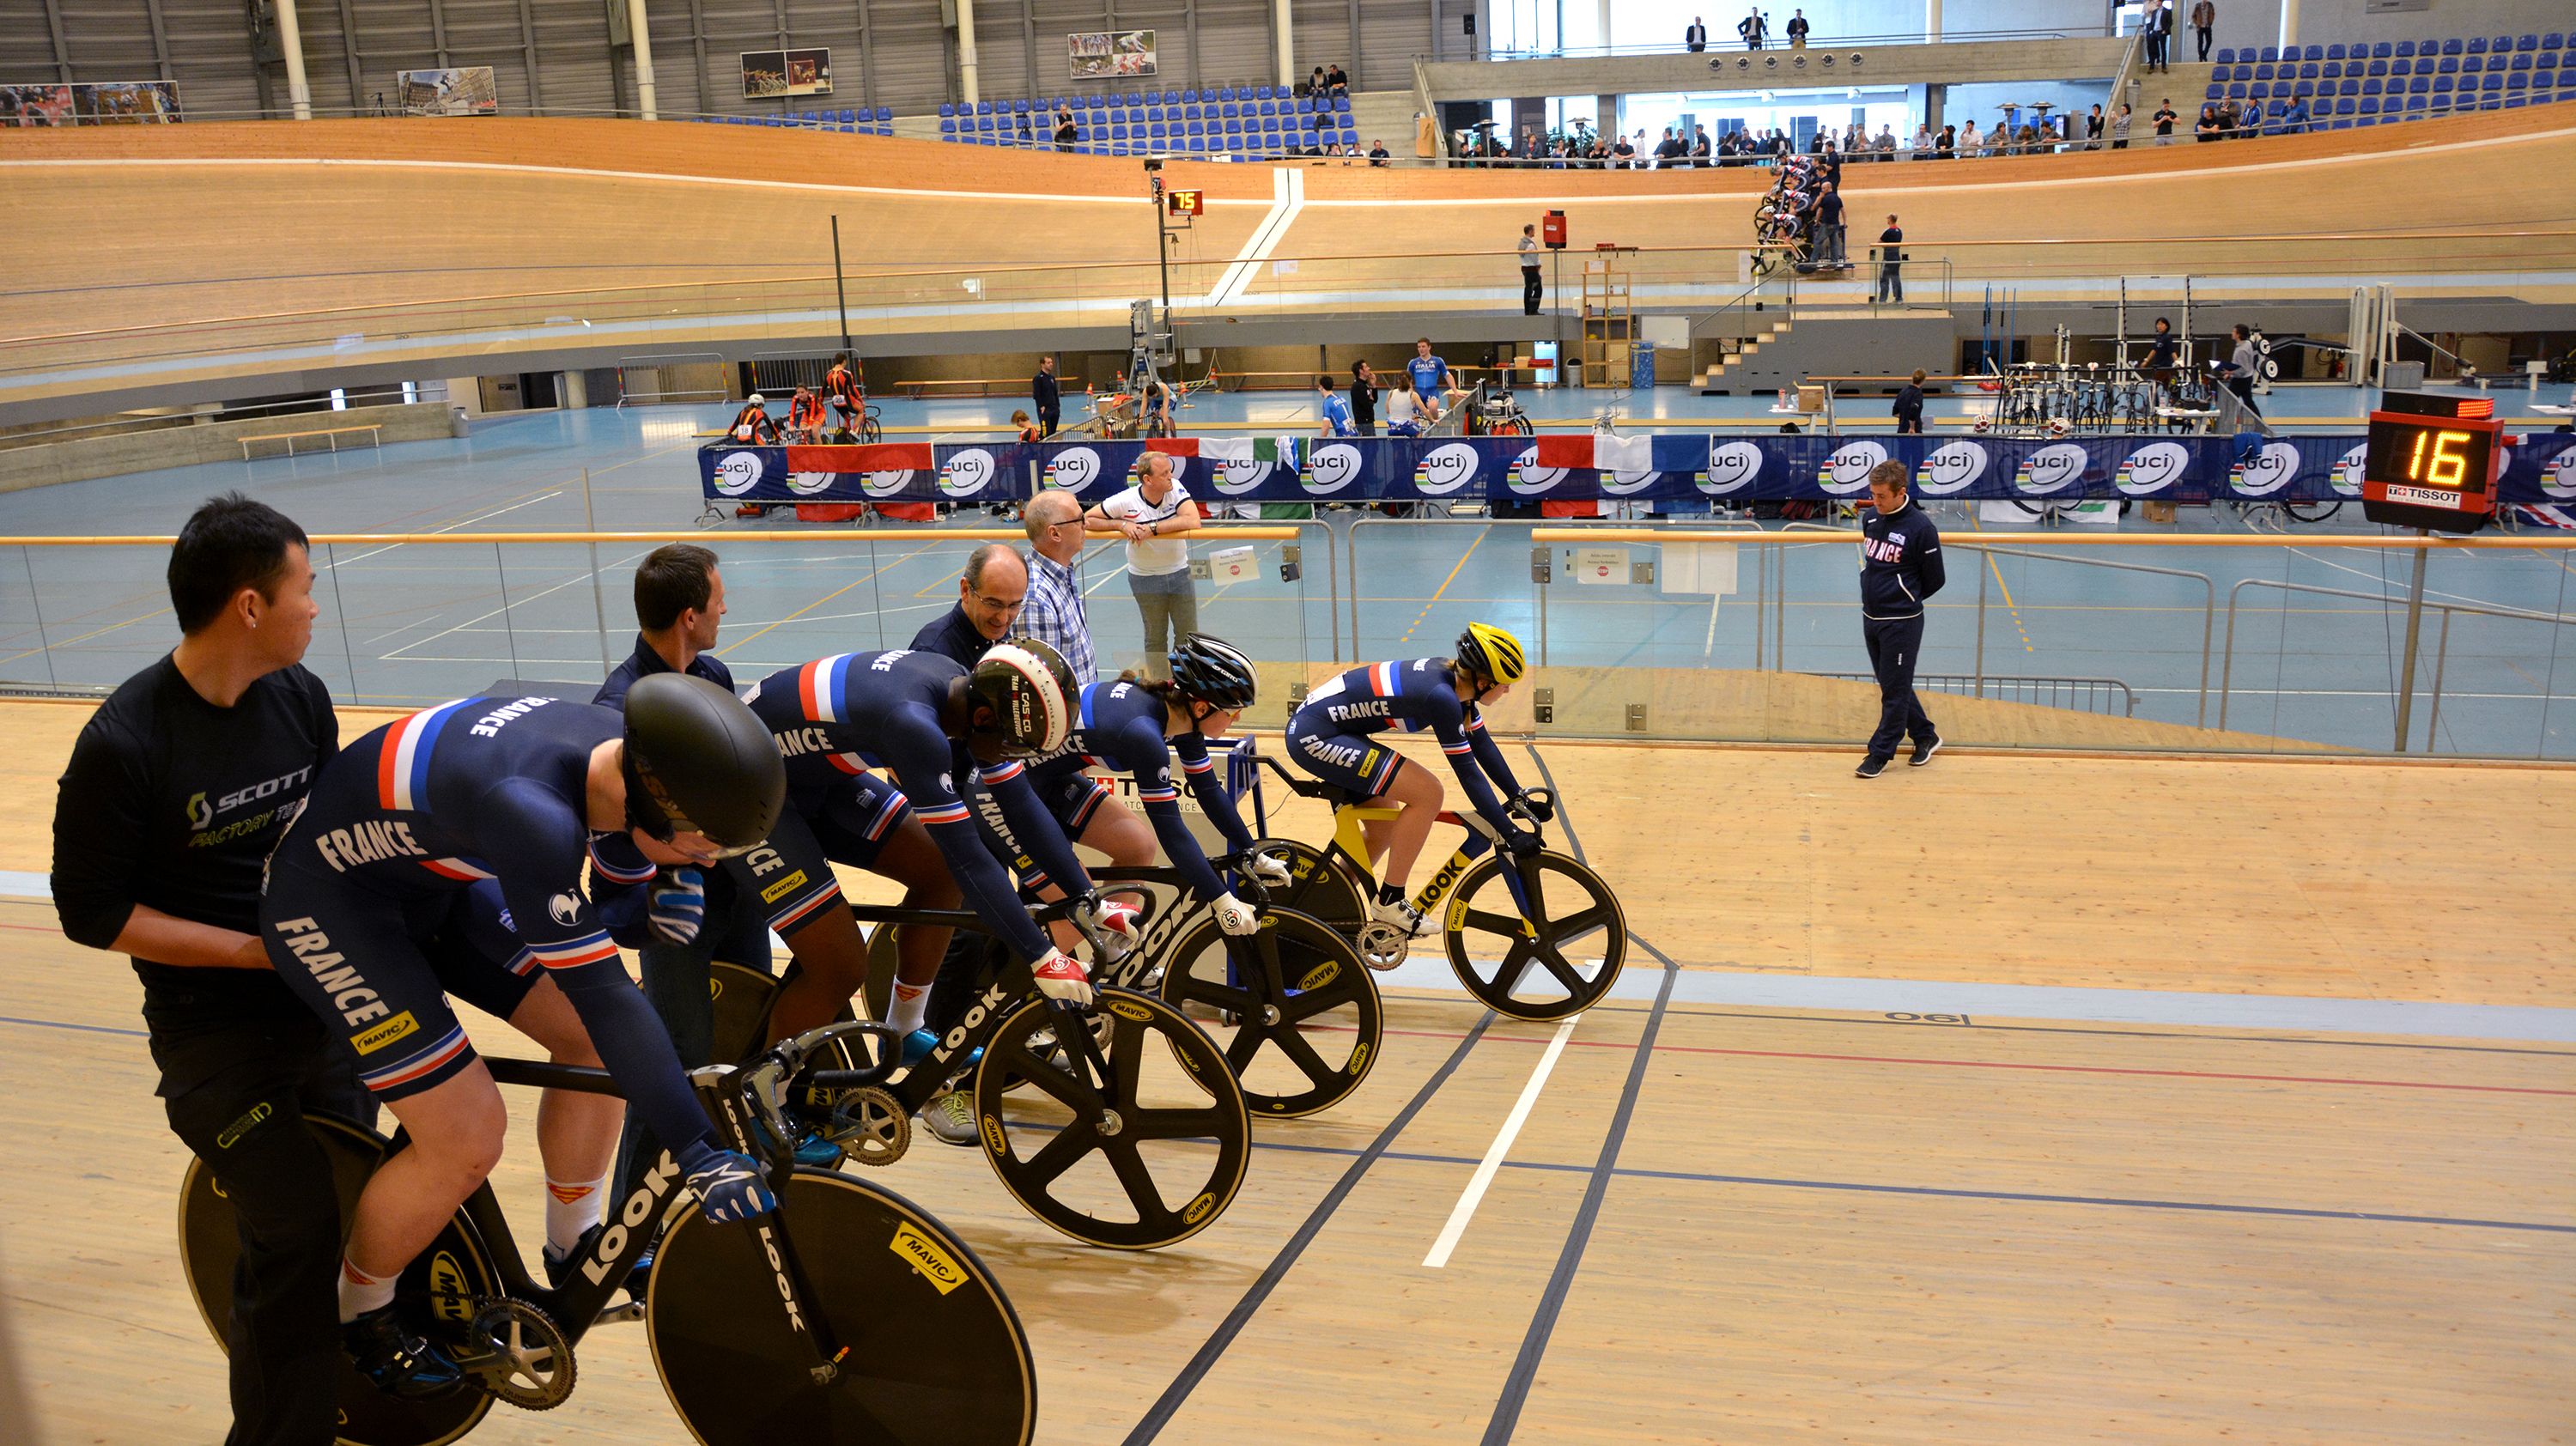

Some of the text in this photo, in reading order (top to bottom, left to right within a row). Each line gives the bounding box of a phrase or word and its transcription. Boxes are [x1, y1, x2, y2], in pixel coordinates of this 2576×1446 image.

[1175, 192, 1195, 209] 75
[2409, 431, 2471, 486] 16
[2409, 489, 2459, 501] TISSOT
[1864, 538, 1903, 563] RANCE
[470, 697, 558, 738] RANCE
[1327, 701, 1391, 722] FRANCE
[774, 727, 834, 758] ANCE
[1299, 734, 1362, 769] FRANCE
[216, 764, 313, 814] SCOTT
[188, 810, 275, 848] FACTORY
[316, 820, 428, 872] FRANCE
[770, 880, 796, 897] MAVIC
[1418, 858, 1466, 909] LOOK
[1454, 905, 1462, 927] MAVIC
[1099, 886, 1197, 987] OOK
[275, 916, 391, 1027] FRANCE
[1304, 964, 1334, 988] MAVIC
[933, 982, 1007, 1064] LOOK
[1115, 1004, 1146, 1018] MAVIC
[363, 1023, 401, 1047] MAVIC
[1352, 1048, 1366, 1071] MAVIC
[866, 1091, 897, 1114] SHIMANO
[723, 1098, 750, 1155] LOOK
[987, 1121, 1003, 1149] MAVIC
[581, 1148, 681, 1286] LOOK
[1188, 1197, 1211, 1219] MAVIC
[907, 1240, 949, 1277] MAVIC
[438, 1271, 462, 1321] MAV
[759, 1226, 805, 1333] LOOK
